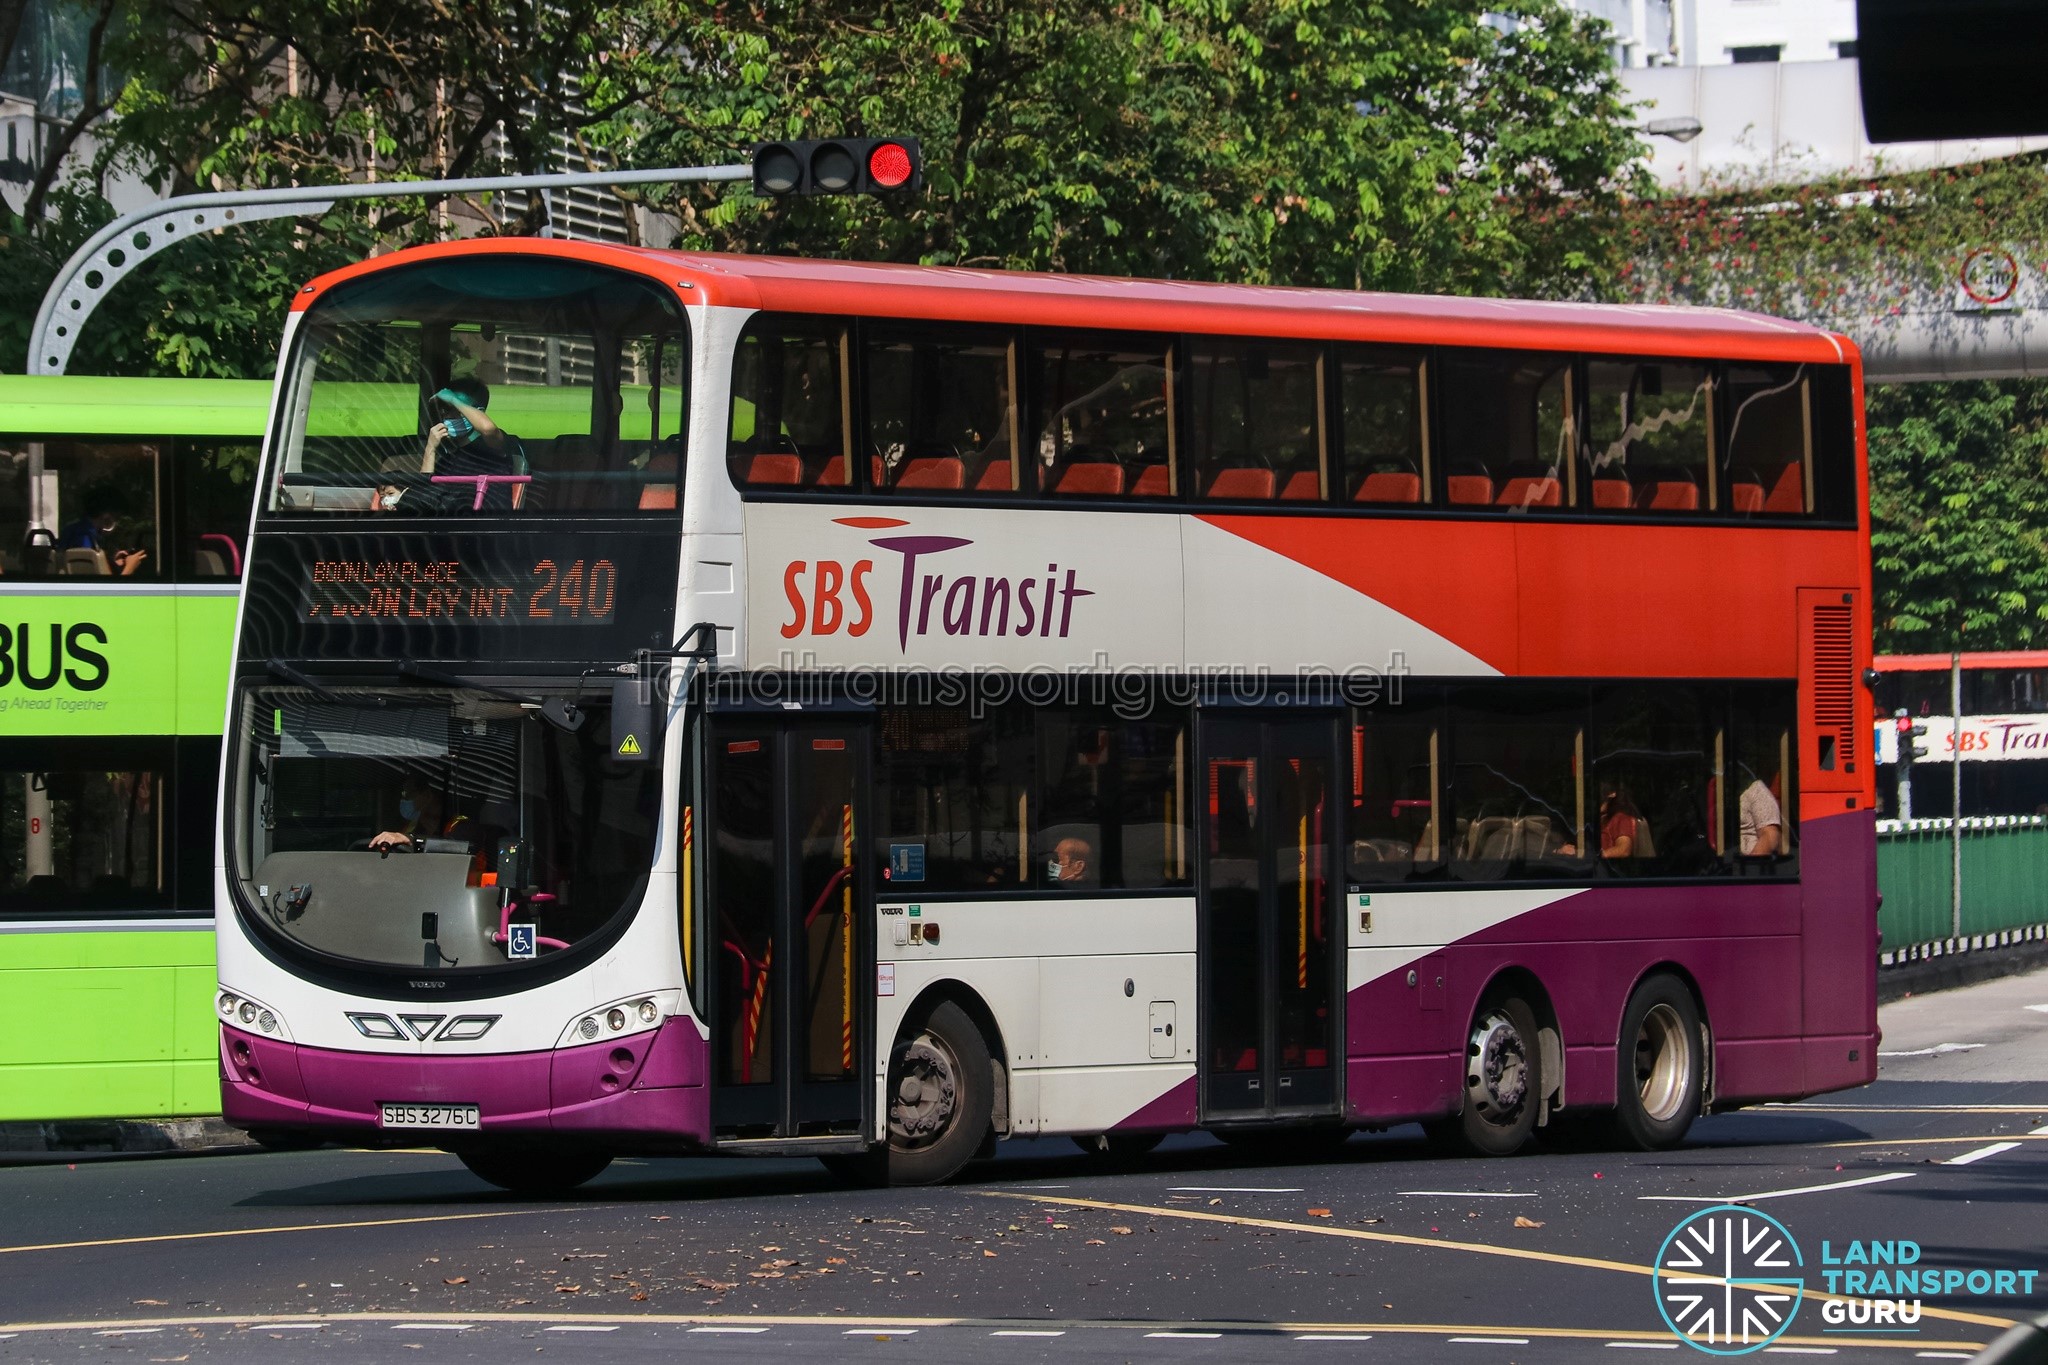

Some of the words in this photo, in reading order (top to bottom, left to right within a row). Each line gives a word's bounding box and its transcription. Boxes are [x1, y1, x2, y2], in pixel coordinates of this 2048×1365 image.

[313, 562, 360, 583] BOON
[363, 562, 399, 583] LAY
[400, 562, 460, 583] PLACE
[528, 559, 617, 618] 240
[780, 559, 873, 639] SBS
[868, 535, 1096, 655] Transit
[408, 588, 462, 618] LAY
[469, 588, 514, 618] INT
[11, 697, 52, 711] Ahead
[55, 697, 108, 714] Together
[1945, 732, 1989, 751] SBS
